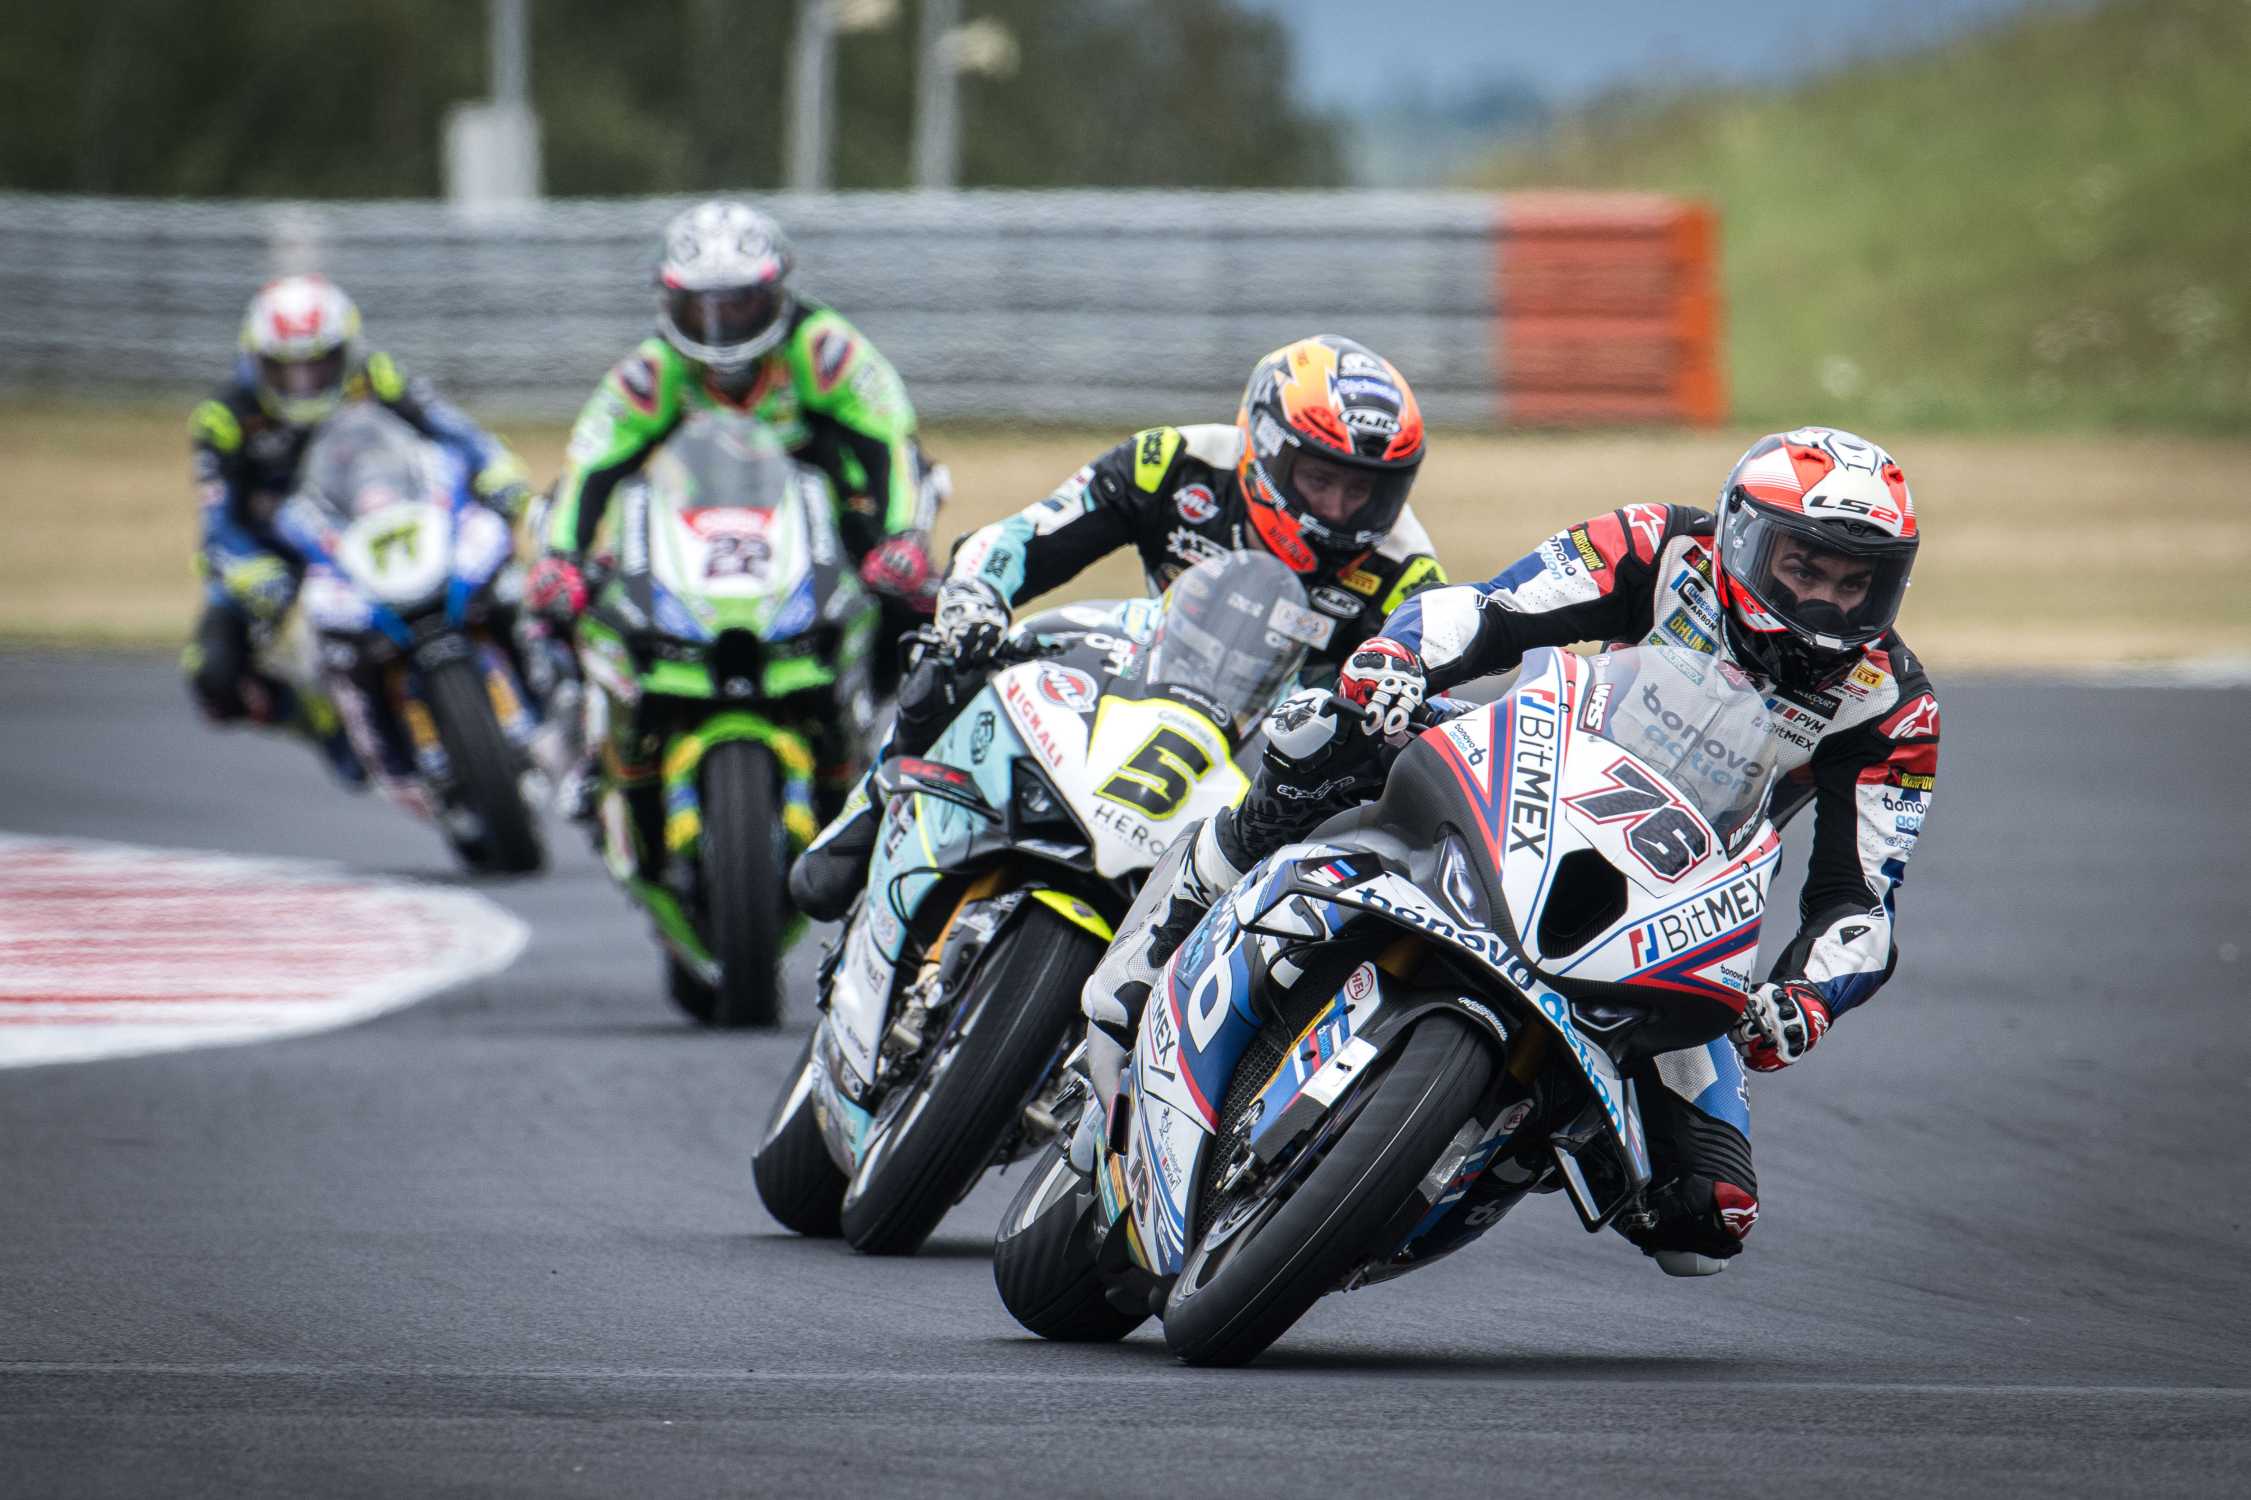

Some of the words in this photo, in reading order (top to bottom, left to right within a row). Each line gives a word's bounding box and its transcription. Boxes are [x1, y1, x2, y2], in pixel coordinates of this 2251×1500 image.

[1808, 495, 1899, 524] LS2
[1642, 682, 1764, 779] bonovo
[1643, 724, 1755, 794] action
[1793, 713, 1826, 734] PVM
[1509, 715, 1555, 860] BitMEX
[1560, 755, 1711, 883] 76
[1355, 886, 1538, 992] bonovo
[1659, 873, 1766, 953] BitMEX
[1351, 972, 1365, 998] HEL
